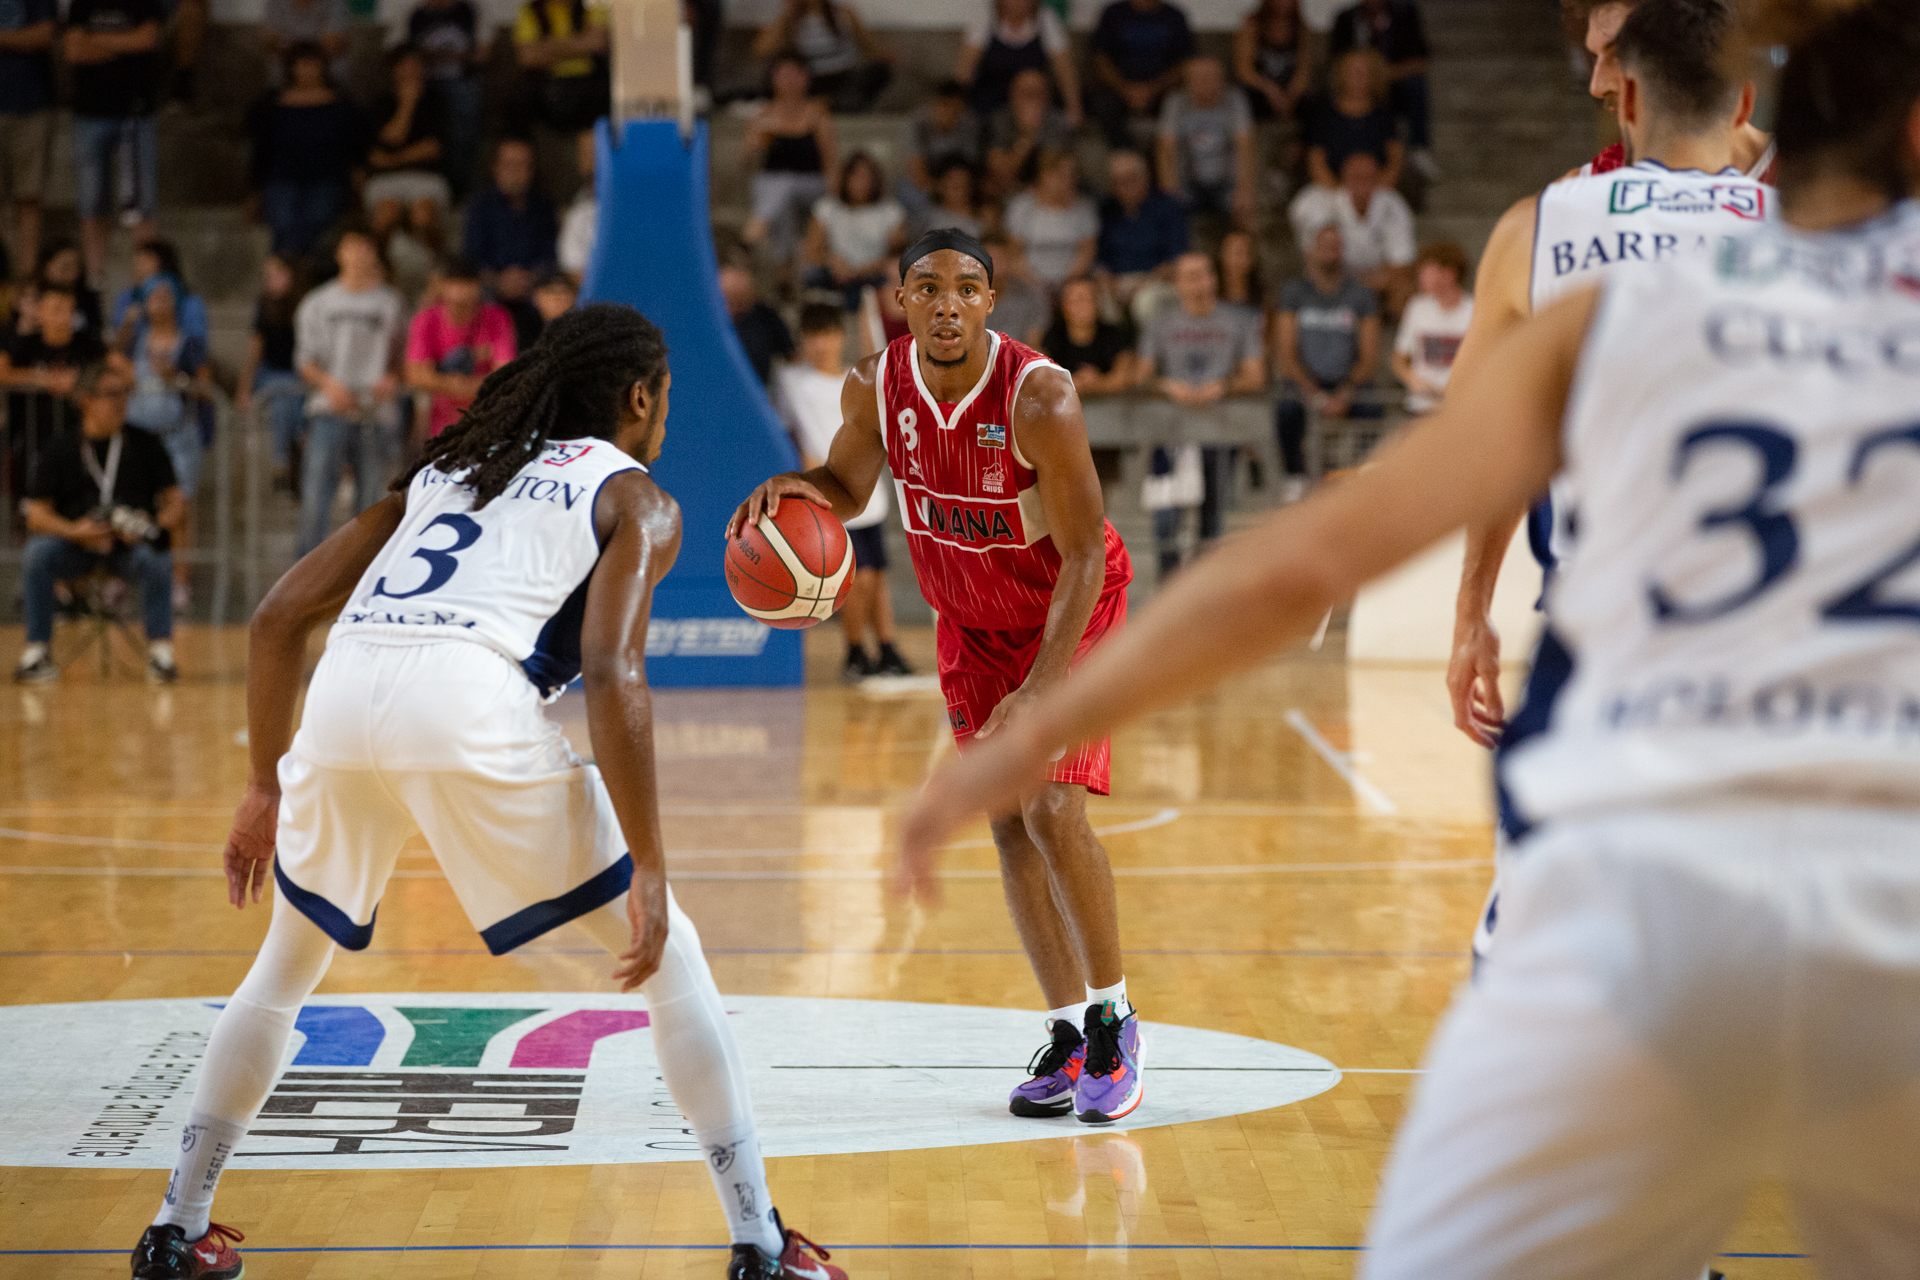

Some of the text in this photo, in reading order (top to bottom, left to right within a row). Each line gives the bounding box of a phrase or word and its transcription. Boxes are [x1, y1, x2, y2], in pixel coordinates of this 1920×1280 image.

[898, 407, 918, 451] 8
[372, 512, 482, 600] 3
[1643, 414, 1920, 628] 32
[100, 1063, 196, 1099] energia
[233, 1071, 586, 1156] HERA
[67, 1103, 175, 1158] ambiente
